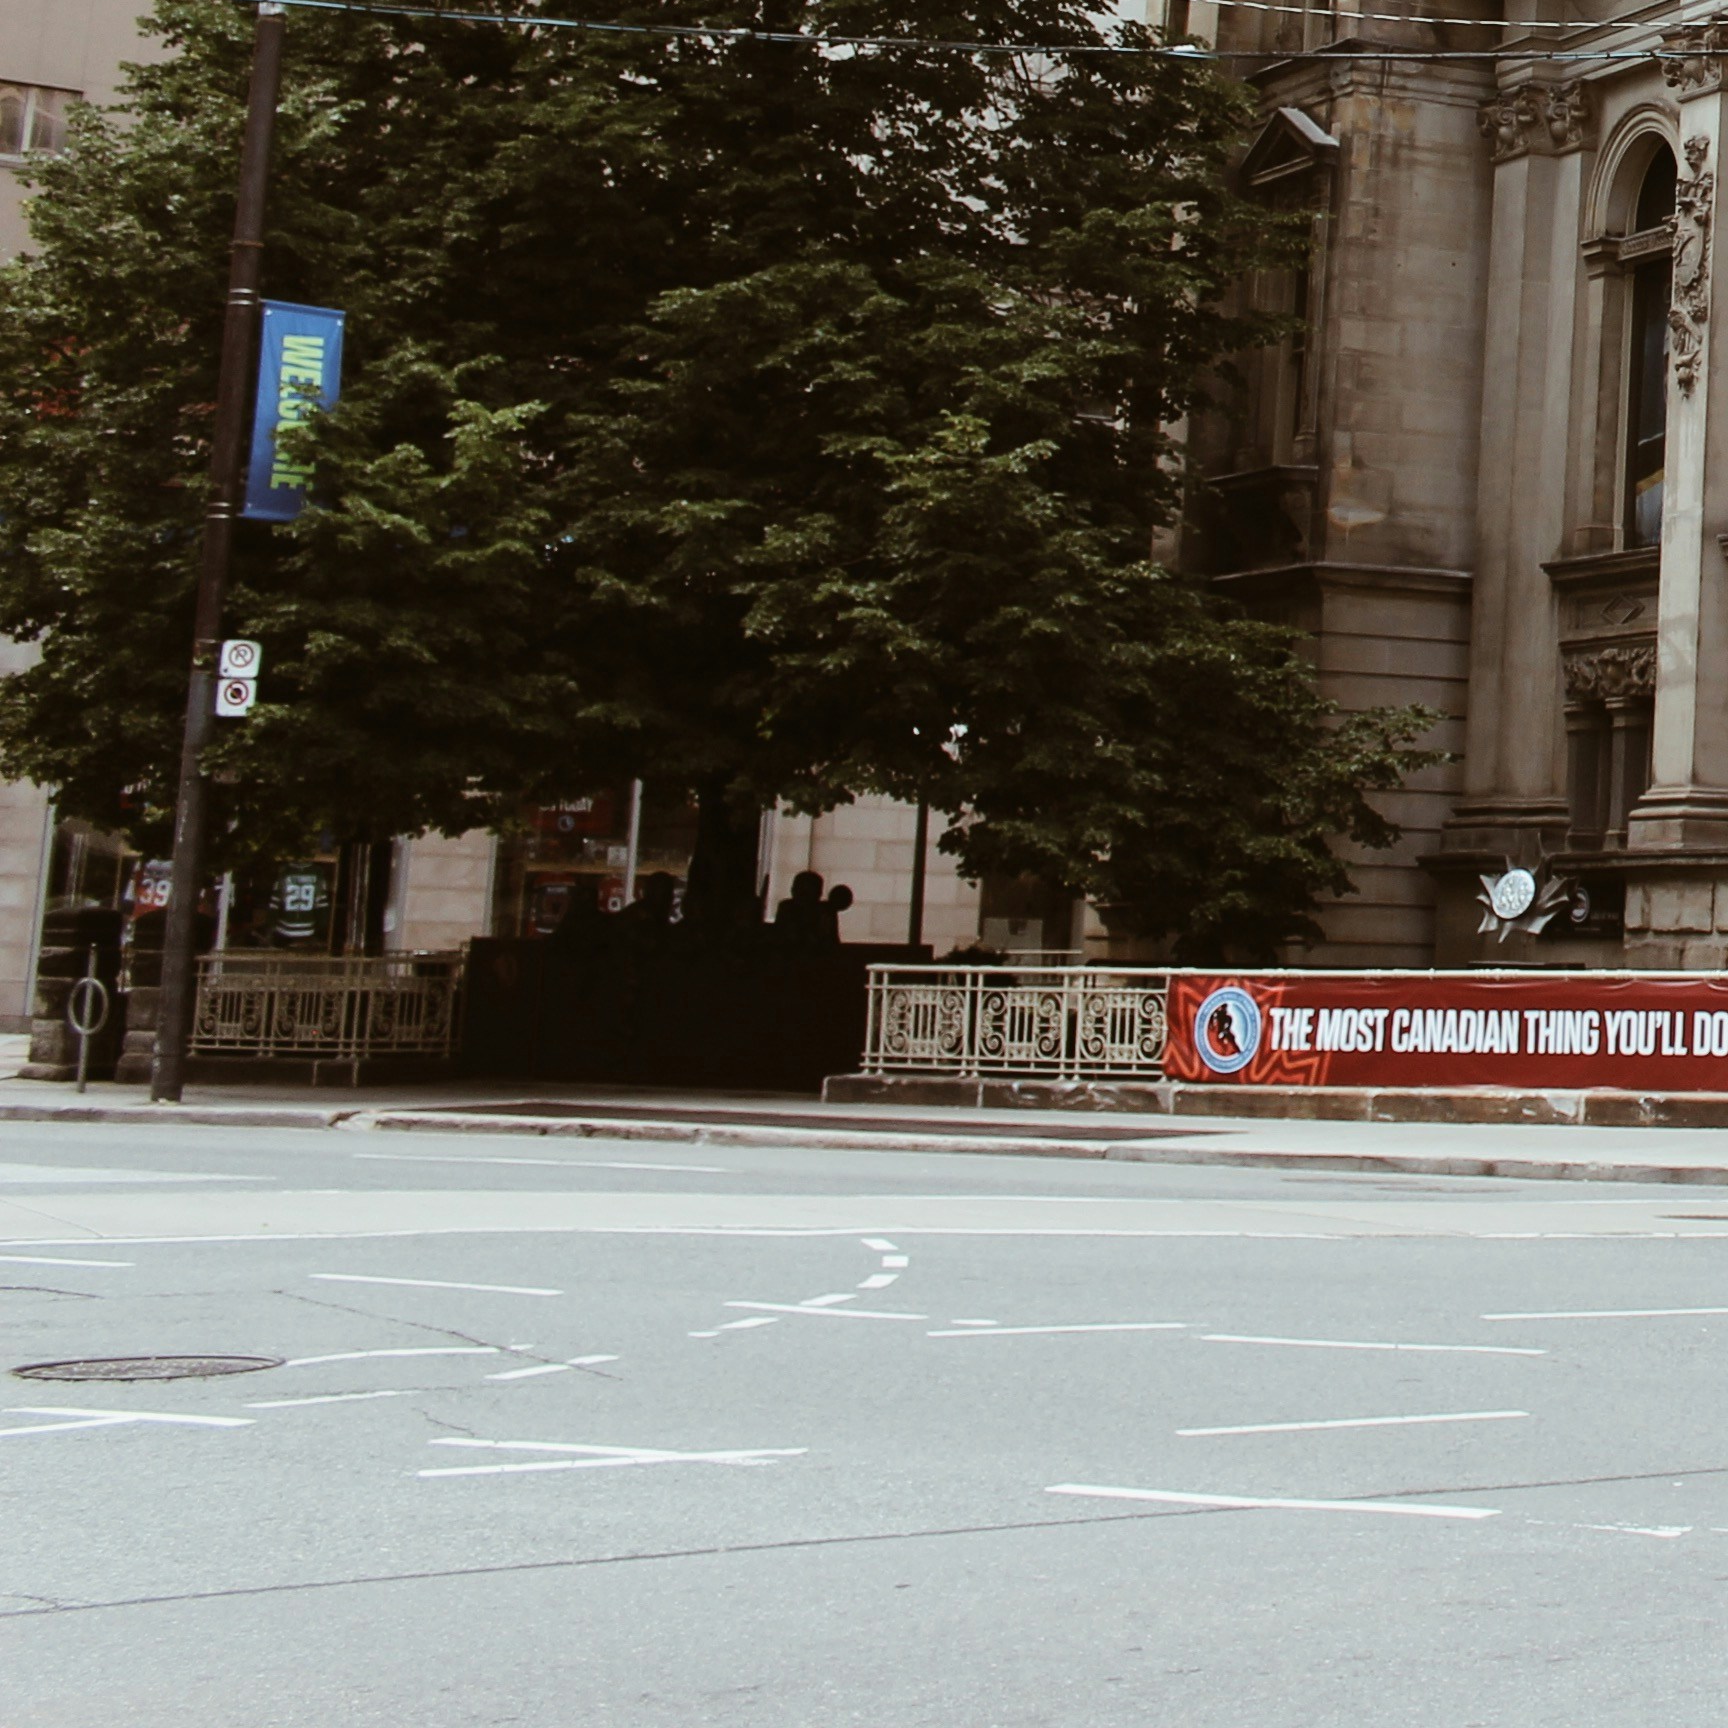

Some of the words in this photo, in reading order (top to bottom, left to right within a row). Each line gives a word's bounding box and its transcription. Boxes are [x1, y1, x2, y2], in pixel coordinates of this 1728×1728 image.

[285, 884, 316, 912] 29
[1269, 1006, 1314, 1051] THE
[1316, 1007, 1389, 1052] MOST
[1391, 1008, 1519, 1055] CANADIAN
[1523, 1009, 1600, 1056] THING
[1603, 1010, 1688, 1057] YOU'LL
